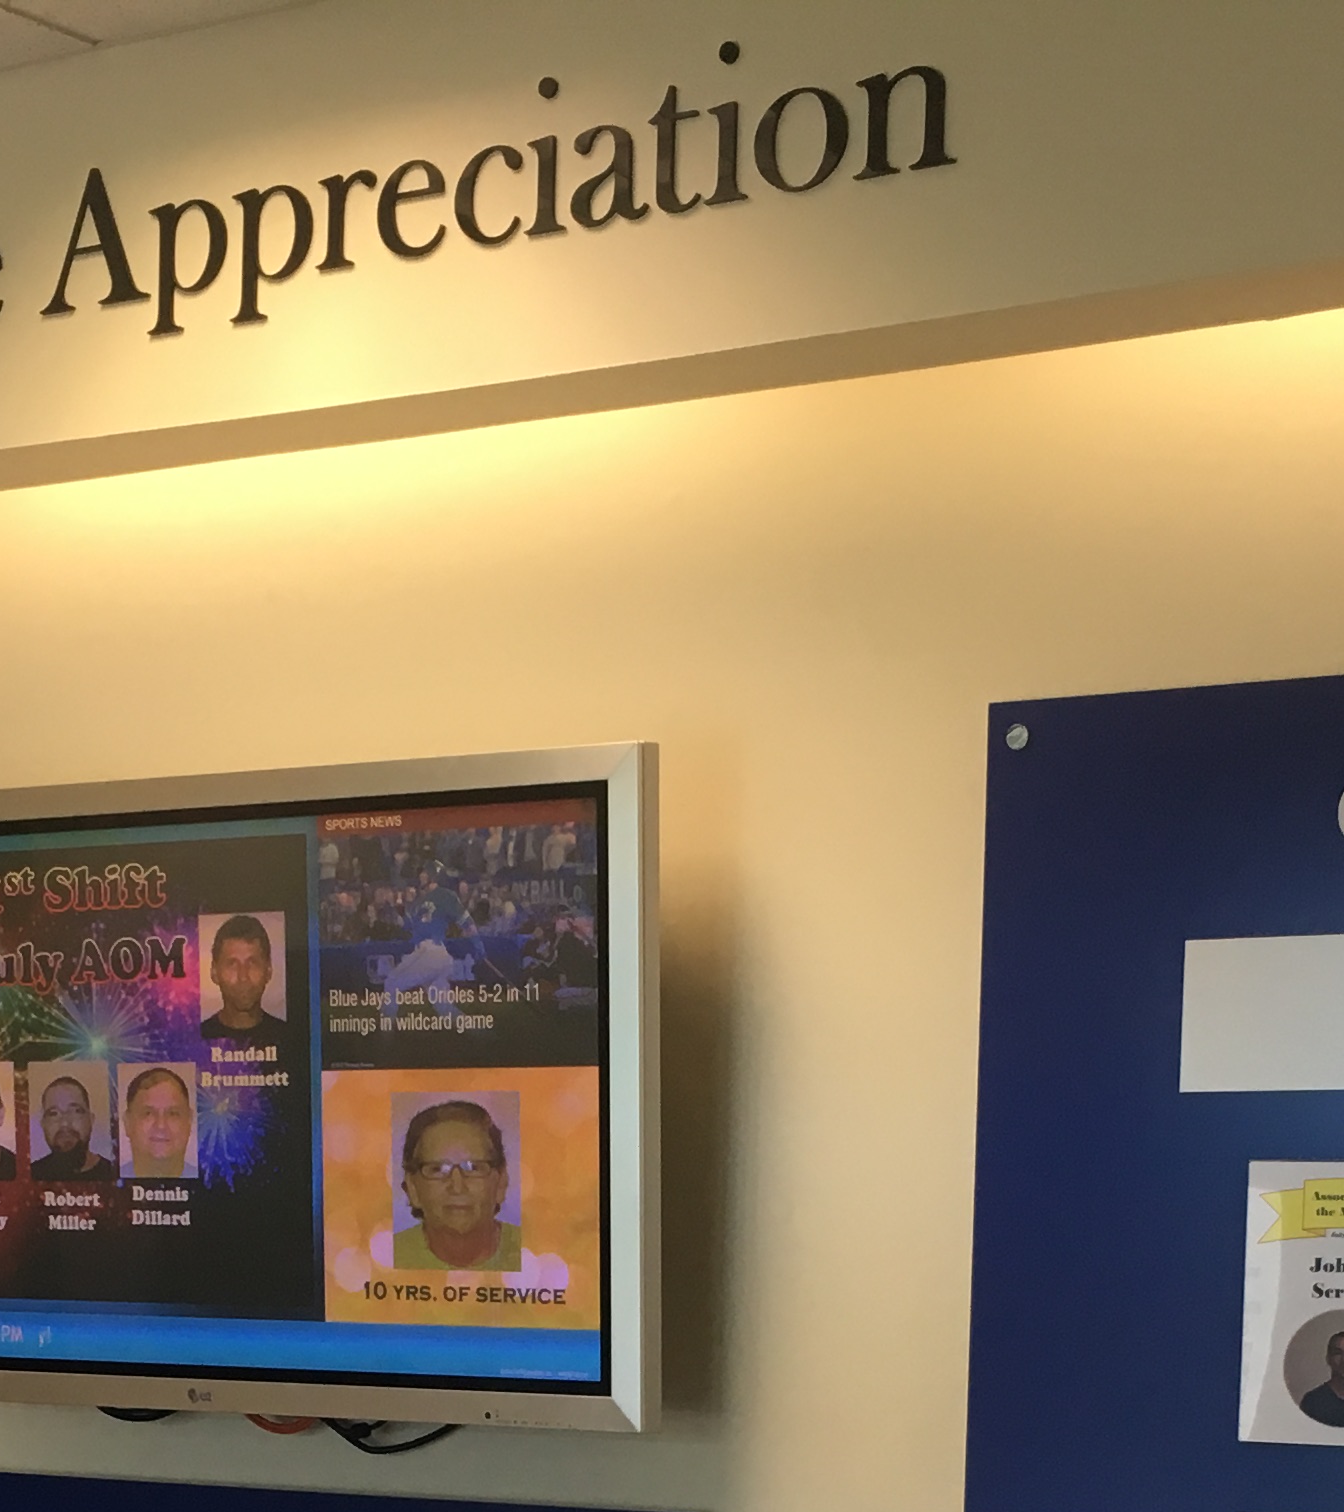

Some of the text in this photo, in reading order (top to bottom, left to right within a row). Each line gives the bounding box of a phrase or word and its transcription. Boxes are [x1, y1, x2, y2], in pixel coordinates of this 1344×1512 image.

[39, 40, 958, 341] Appreciation
[325, 815, 402, 830] SPORTS NEWS
[42, 862, 167, 914] Shift
[71, 935, 188, 985] AOM
[329, 983, 540, 1010] Blue Jays beat Orioles 5-2 in 11
[329, 1012, 494, 1036] innings in wildcard game
[211, 1046, 277, 1063] Randall
[201, 1071, 289, 1087] Brummett
[44, 1191, 101, 1207] Robert
[132, 1185, 189, 1202] Dennis
[131, 1210, 191, 1227] Dillard
[1316, 1207, 1336, 1217] the
[48, 1215, 96, 1231] Miller
[363, 1281, 566, 1305] 10 YRS. OF SERVICE
[1, 1325, 23, 1342] PM
